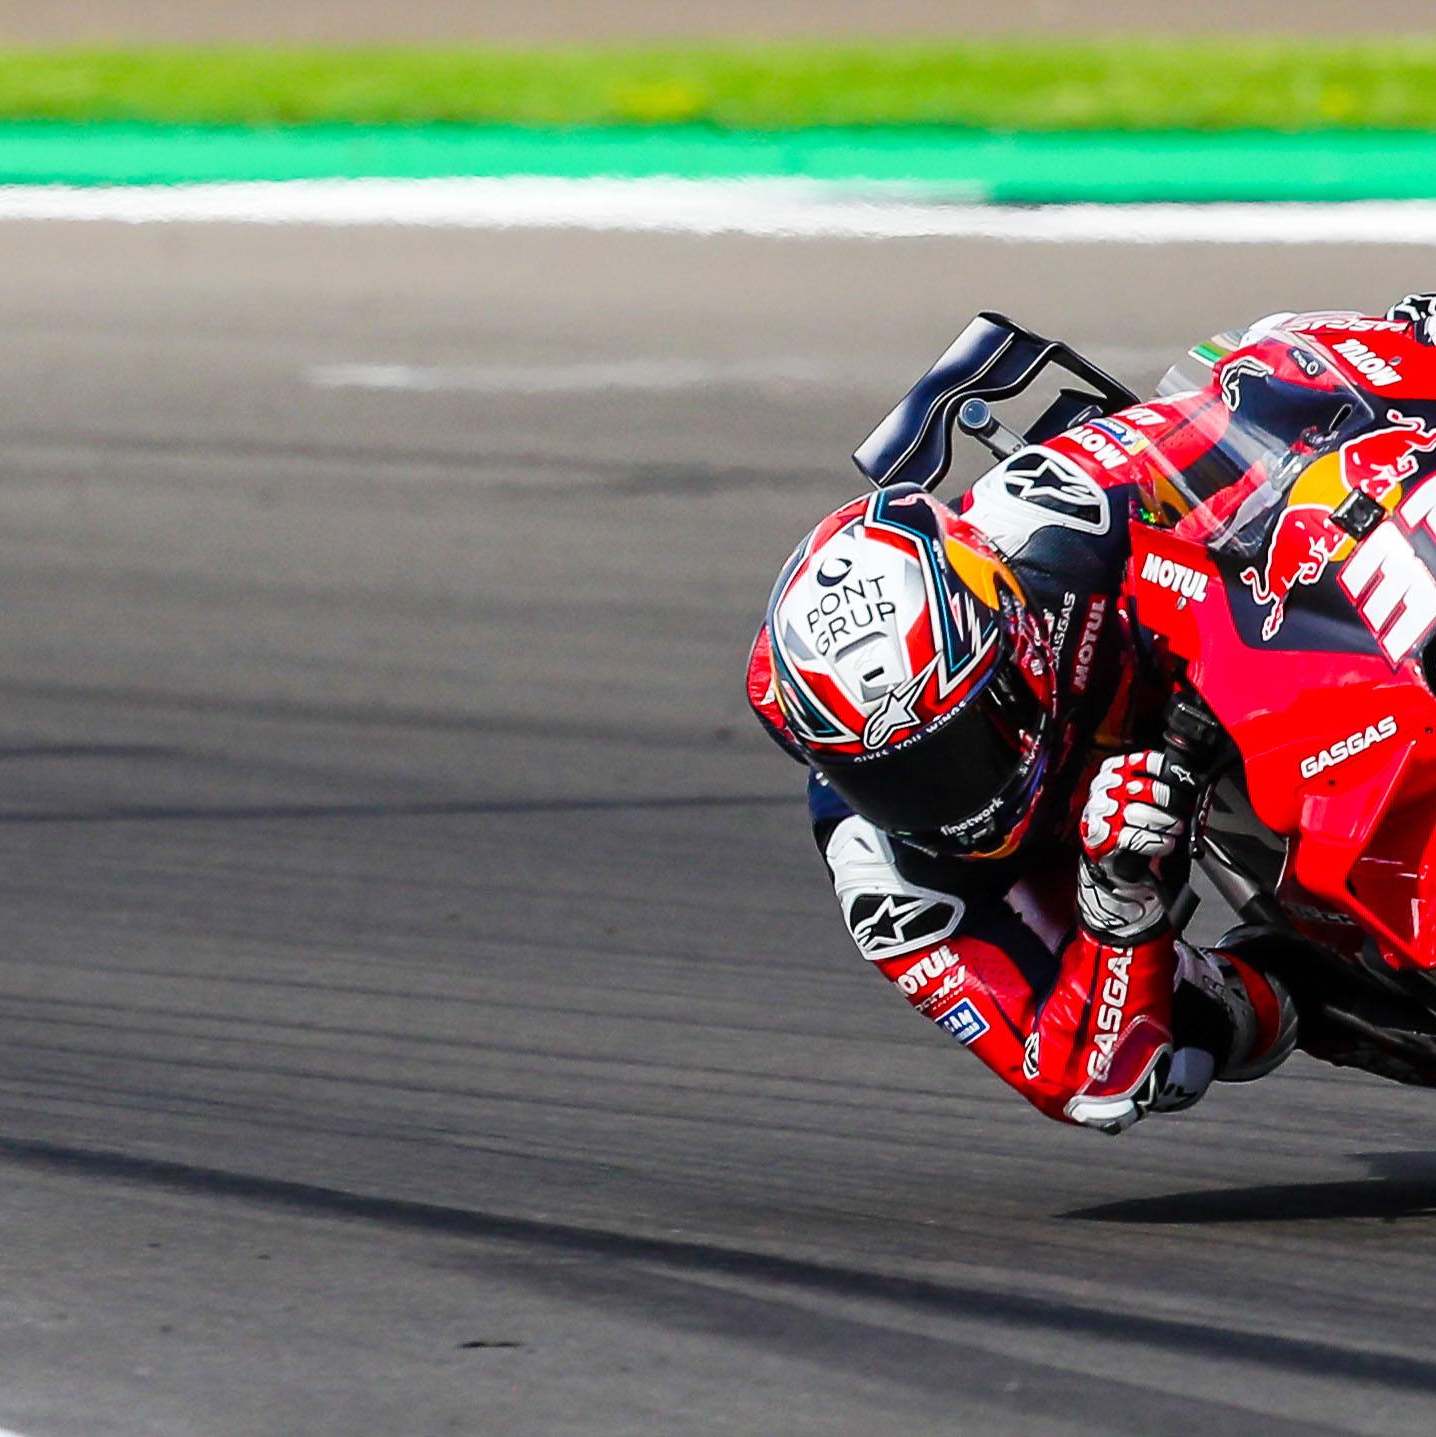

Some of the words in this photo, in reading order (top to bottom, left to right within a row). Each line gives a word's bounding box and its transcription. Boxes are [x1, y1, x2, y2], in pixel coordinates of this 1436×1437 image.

[1331, 338, 1403, 387] MOTUL
[1057, 426, 1128, 470] MOT
[807, 574, 885, 634] PONT
[1140, 552, 1209, 604] MOTUL
[815, 601, 897, 657] GRUP
[1073, 598, 1107, 691] MOTUL
[1299, 715, 1398, 780] GASGAS
[940, 797, 1004, 836] finetwork
[896, 944, 961, 996] OTUL
